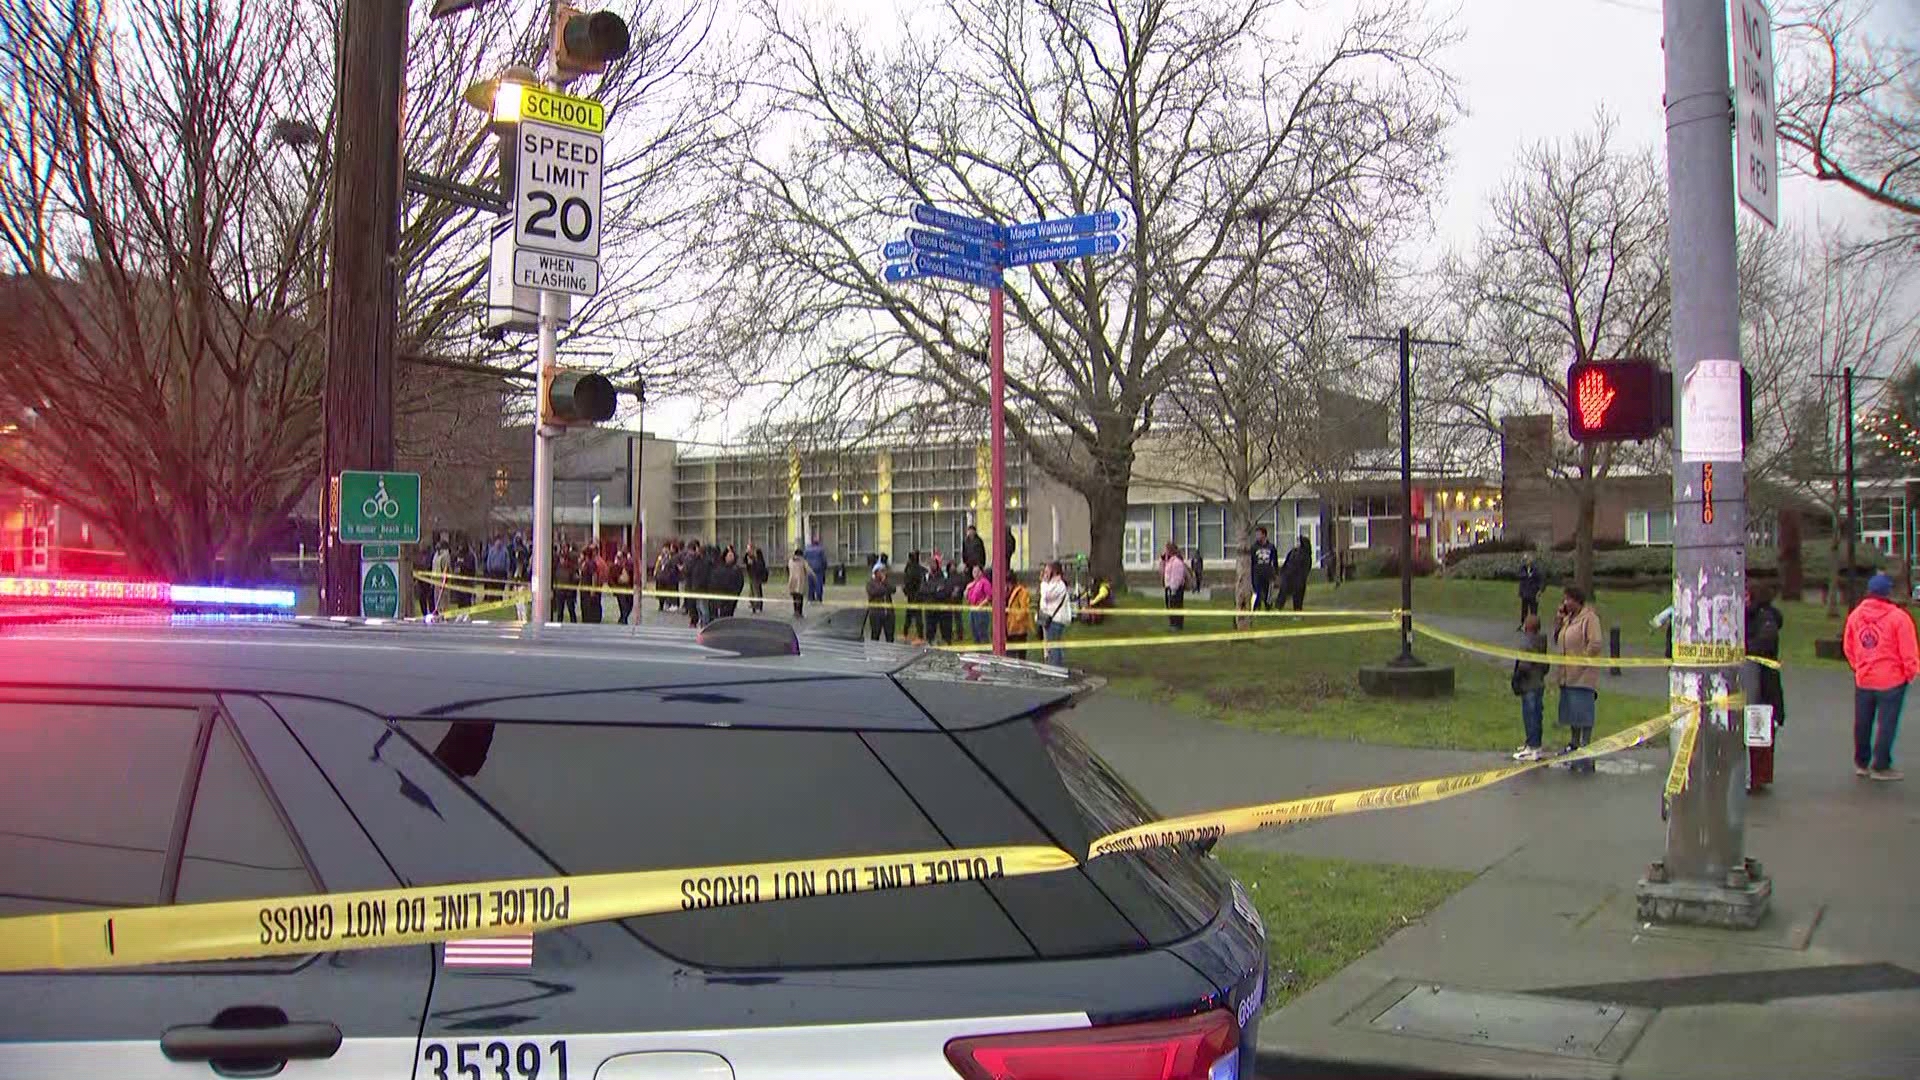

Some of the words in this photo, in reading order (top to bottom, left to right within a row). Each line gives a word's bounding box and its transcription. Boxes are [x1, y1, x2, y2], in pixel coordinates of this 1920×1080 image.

[1742, 3, 1762, 59] NO
[1743, 56, 1767, 107] TURN
[527, 96, 598, 127] SCHOOL
[1751, 110, 1763, 149] ON
[524, 134, 599, 165] SPEED
[531, 161, 590, 190] LIMIT
[1750, 154, 1767, 196] RED
[524, 190, 593, 243] 20
[1010, 228, 1036, 241] Mapes
[1037, 223, 1074, 237] Walkway
[539, 255, 575, 273] WHEN
[1010, 250, 1028, 263] Lake
[1029, 245, 1078, 261] Washington
[524, 270, 587, 291] FLASHING
[774, 872, 816, 902] NOT
[826, 868, 858, 895] DO
[864, 862, 916, 889] LINE
[433, 891, 483, 931] LINE
[489, 885, 571, 926] POLICE
[681, 877, 760, 911] CROSS
[259, 904, 333, 945] CROSS
[341, 899, 387, 938] NOT
[396, 895, 426, 935] DO
[424, 1039, 568, 1080] 35391
